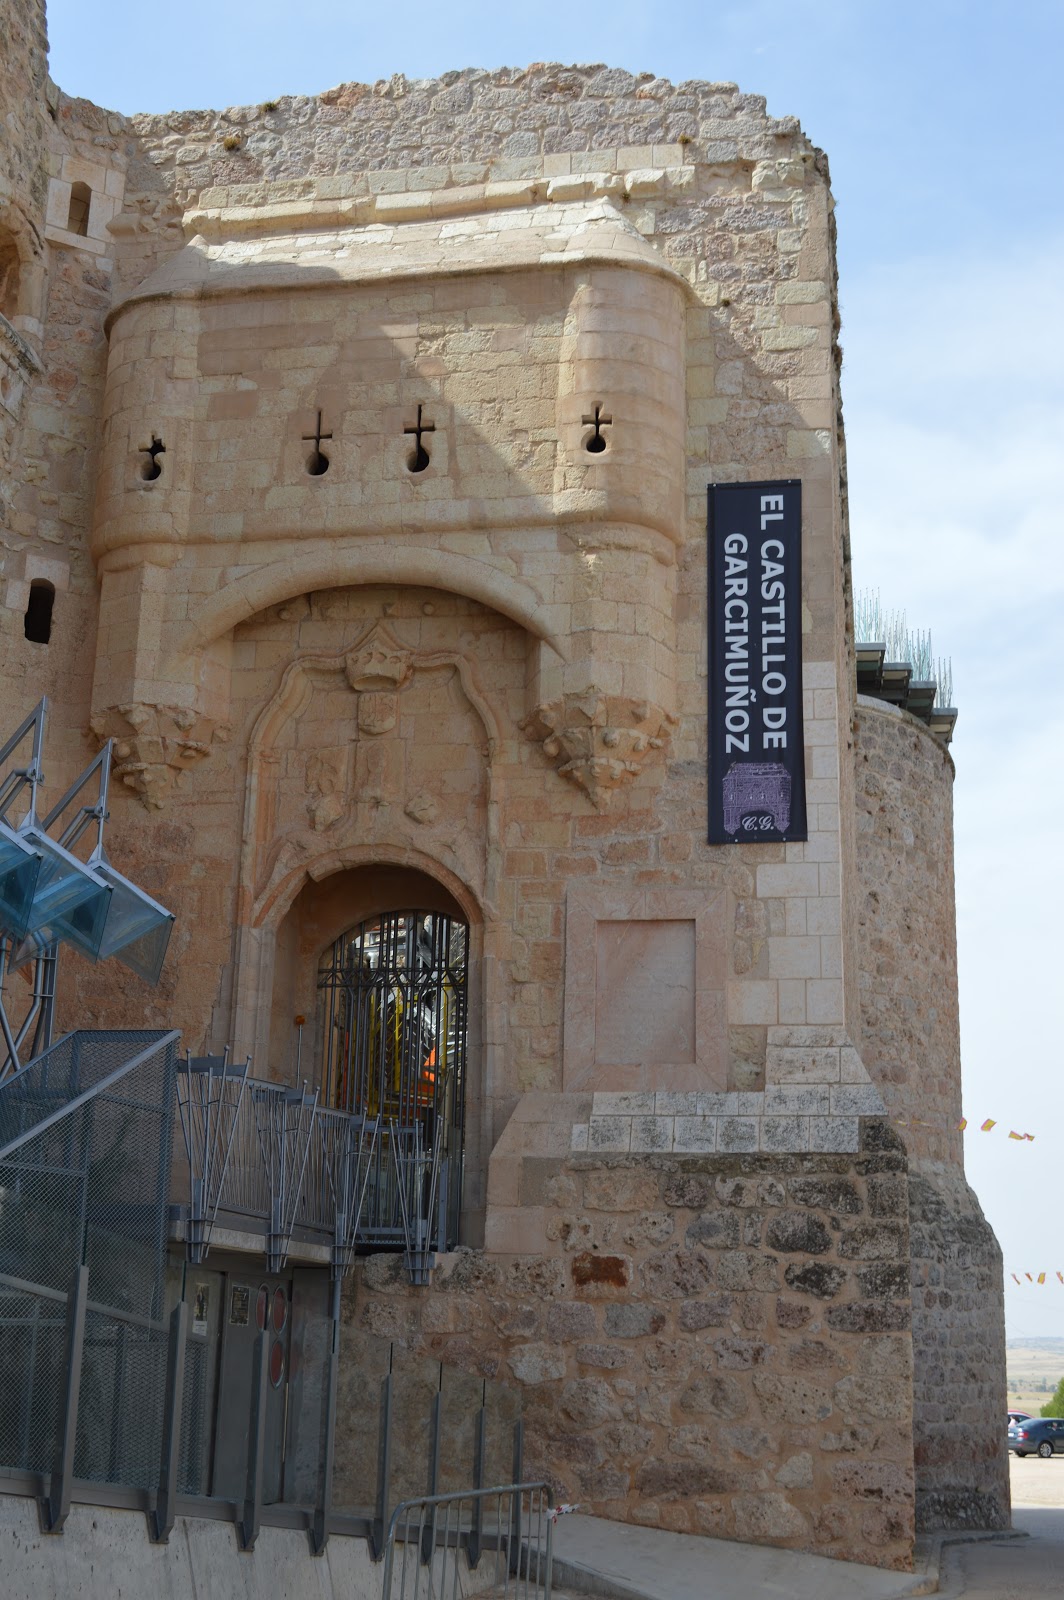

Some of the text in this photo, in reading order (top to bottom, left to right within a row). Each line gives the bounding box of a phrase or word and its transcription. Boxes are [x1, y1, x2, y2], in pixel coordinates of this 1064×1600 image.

[724, 533, 757, 753] GARCIMUÑOZ
[760, 494, 787, 749] EL CASTILLO DE
